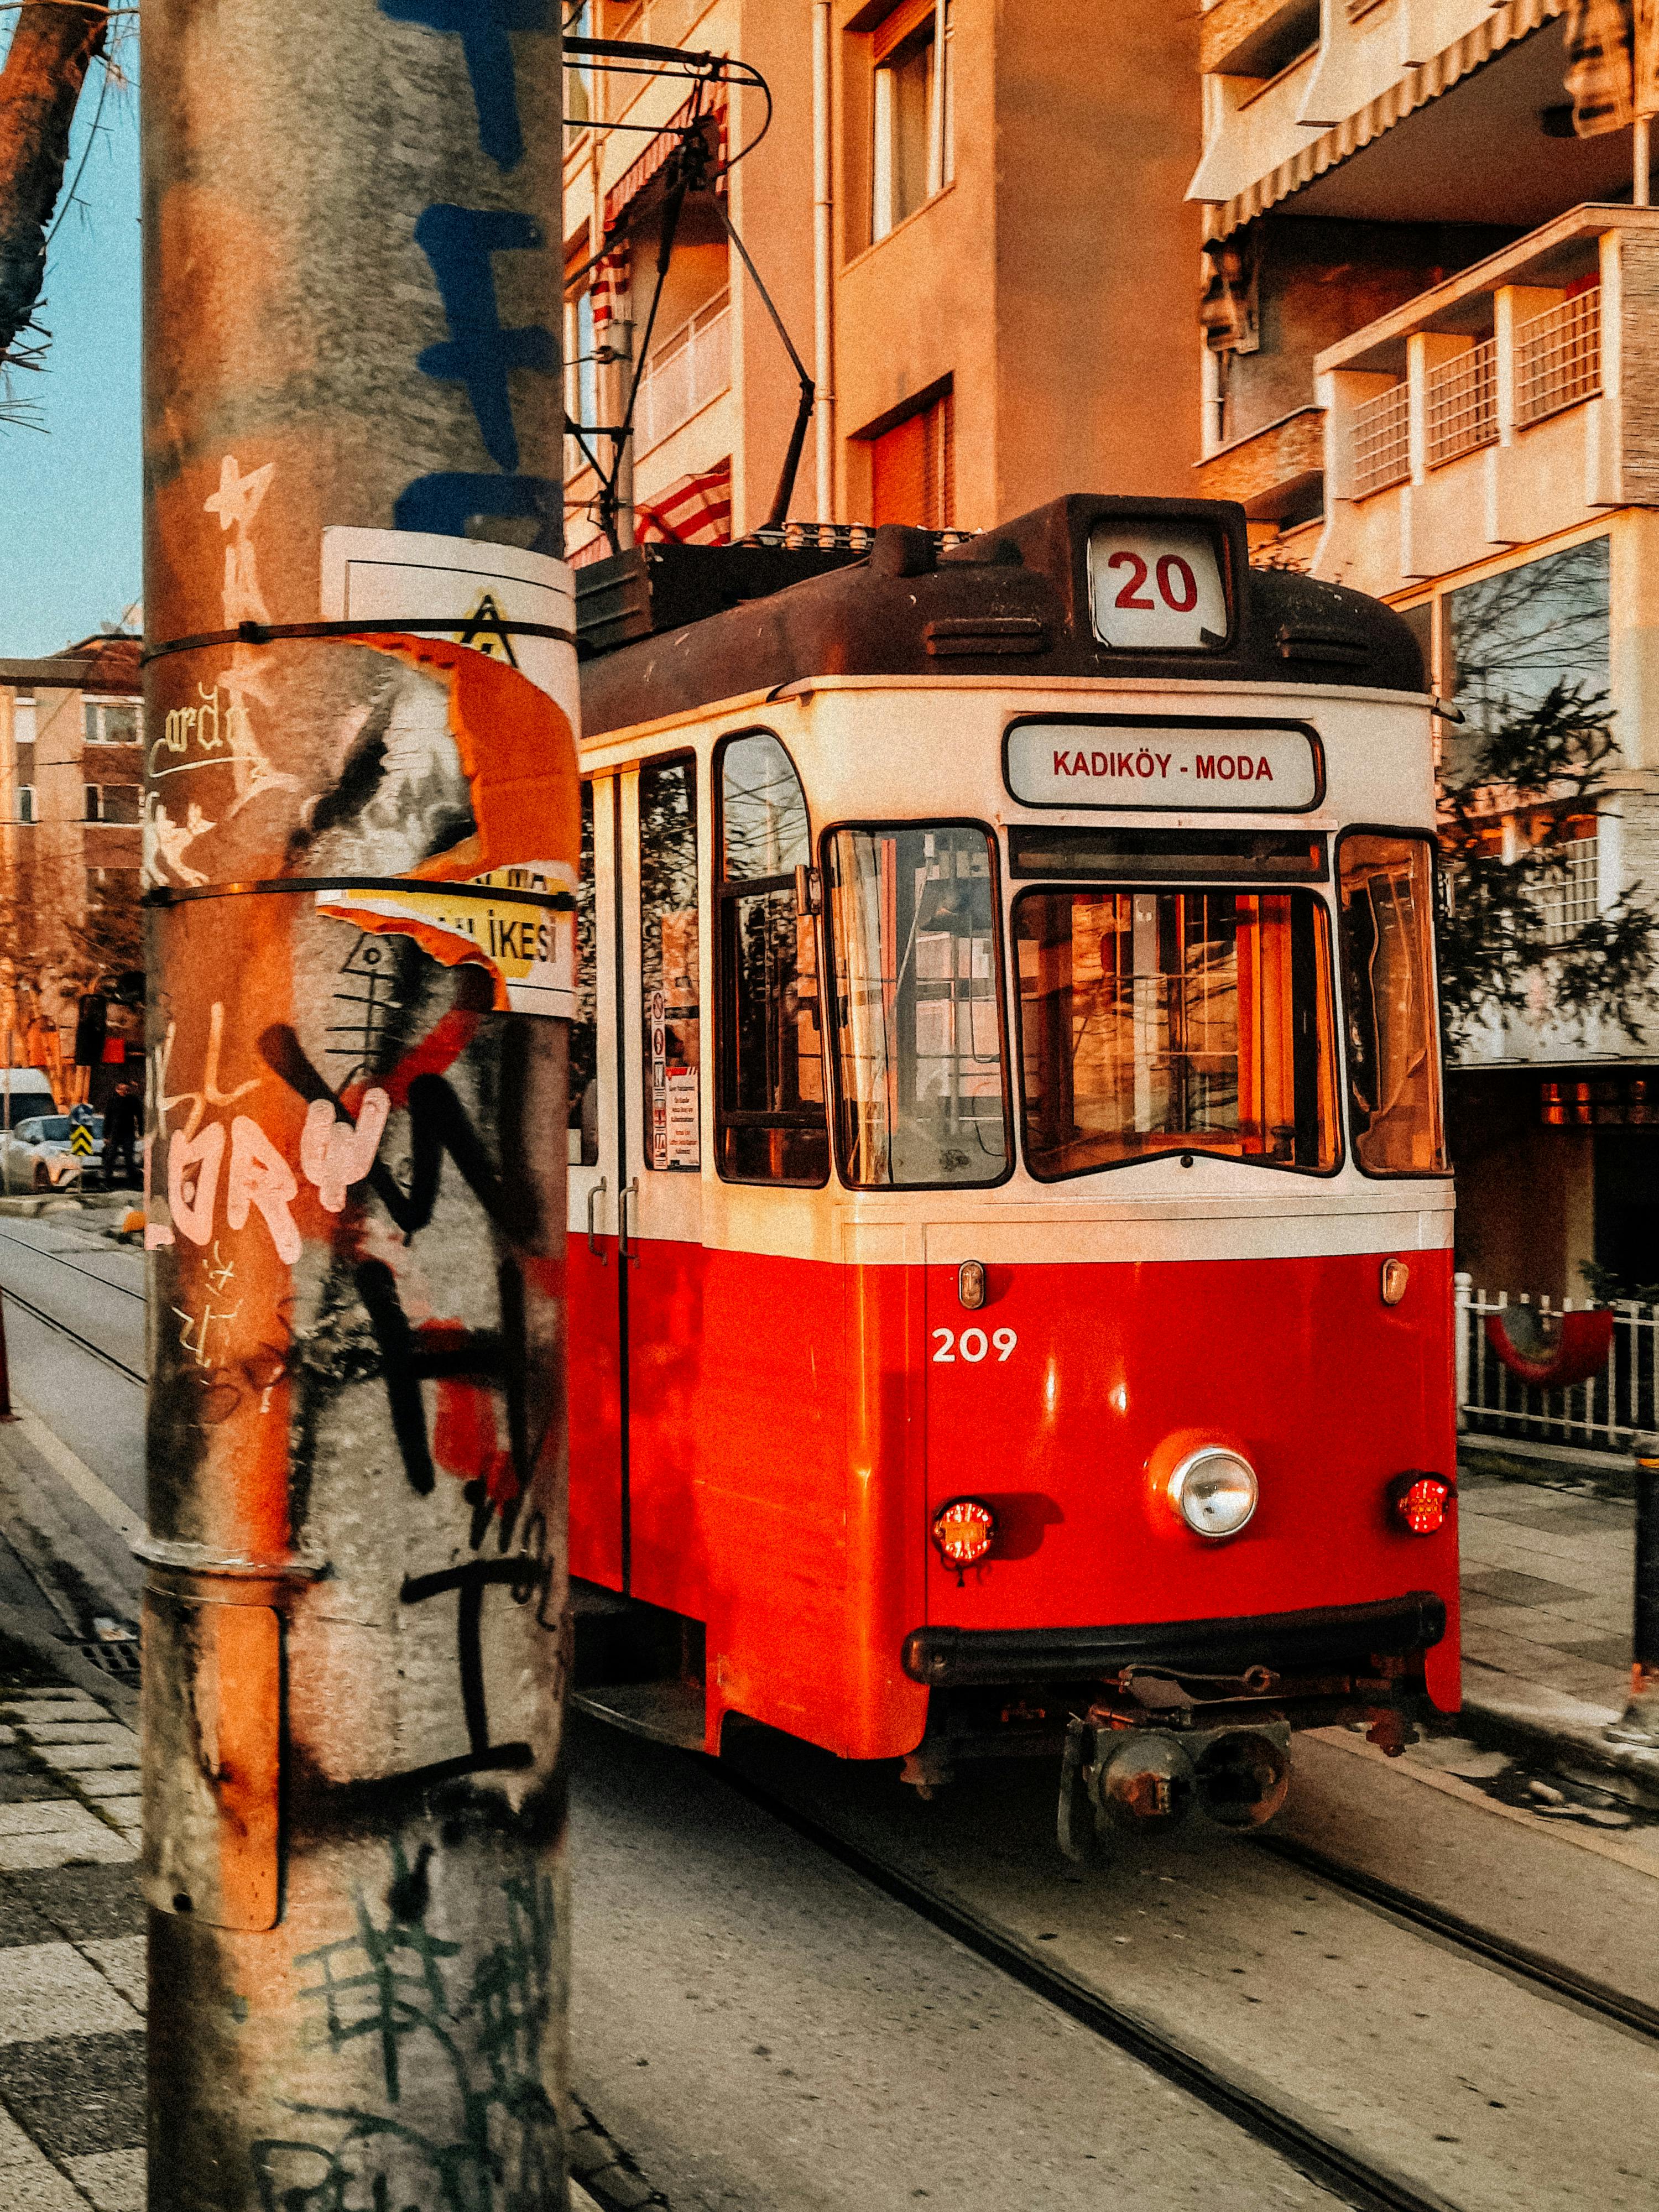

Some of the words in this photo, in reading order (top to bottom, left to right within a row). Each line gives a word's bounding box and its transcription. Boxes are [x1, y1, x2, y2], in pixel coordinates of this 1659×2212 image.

[1108, 551, 1198, 612] 20
[1053, 748, 1172, 778] KADIKÖY
[1195, 754, 1274, 781] MODA
[439, 909, 556, 963] İKESİ
[931, 1327, 1018, 1363] 209
